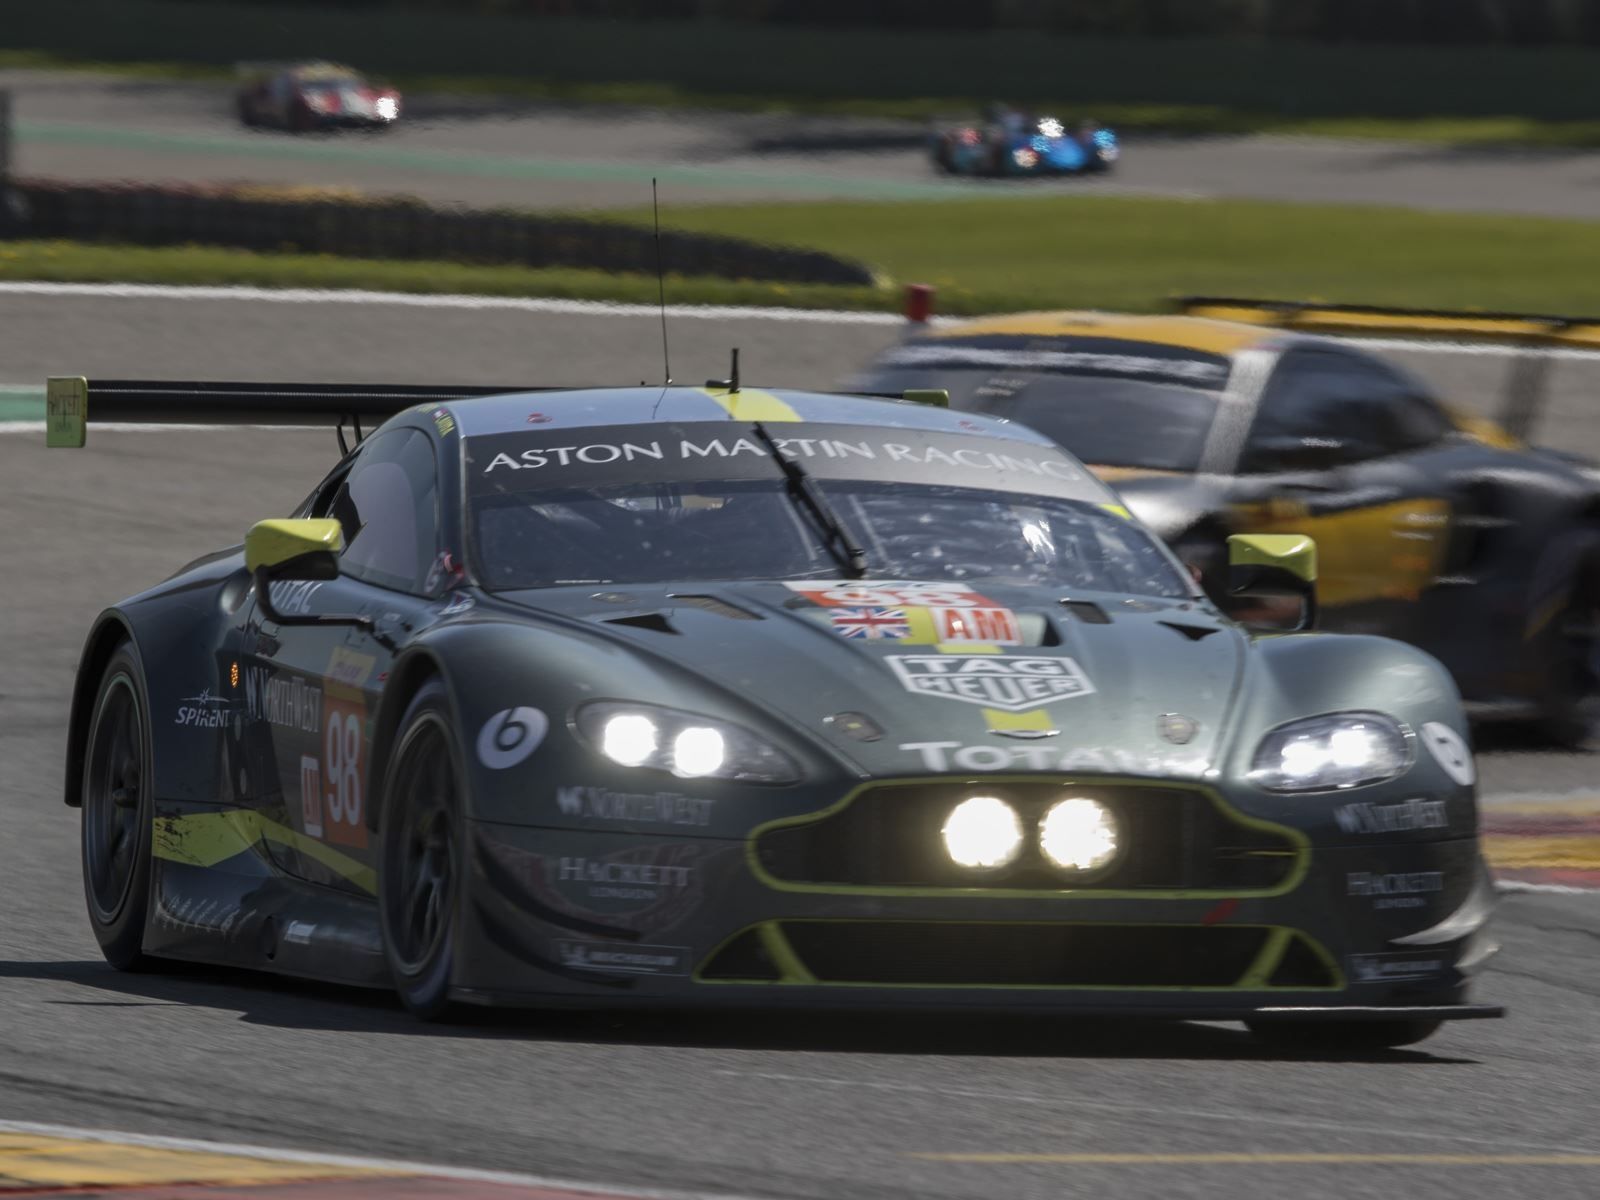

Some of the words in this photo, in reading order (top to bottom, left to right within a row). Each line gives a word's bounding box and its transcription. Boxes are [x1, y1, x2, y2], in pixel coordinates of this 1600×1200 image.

[484, 441, 664, 473] ASTON
[680, 438, 877, 460] MARTIN
[882, 443, 1081, 481] RACING
[943, 609, 1013, 641] AM
[904, 658, 1064, 674] TAG
[918, 677, 1078, 702] HEUER
[174, 706, 231, 728] SPIRENT
[326, 710, 362, 826] 98
[559, 856, 695, 887] HACKETT
